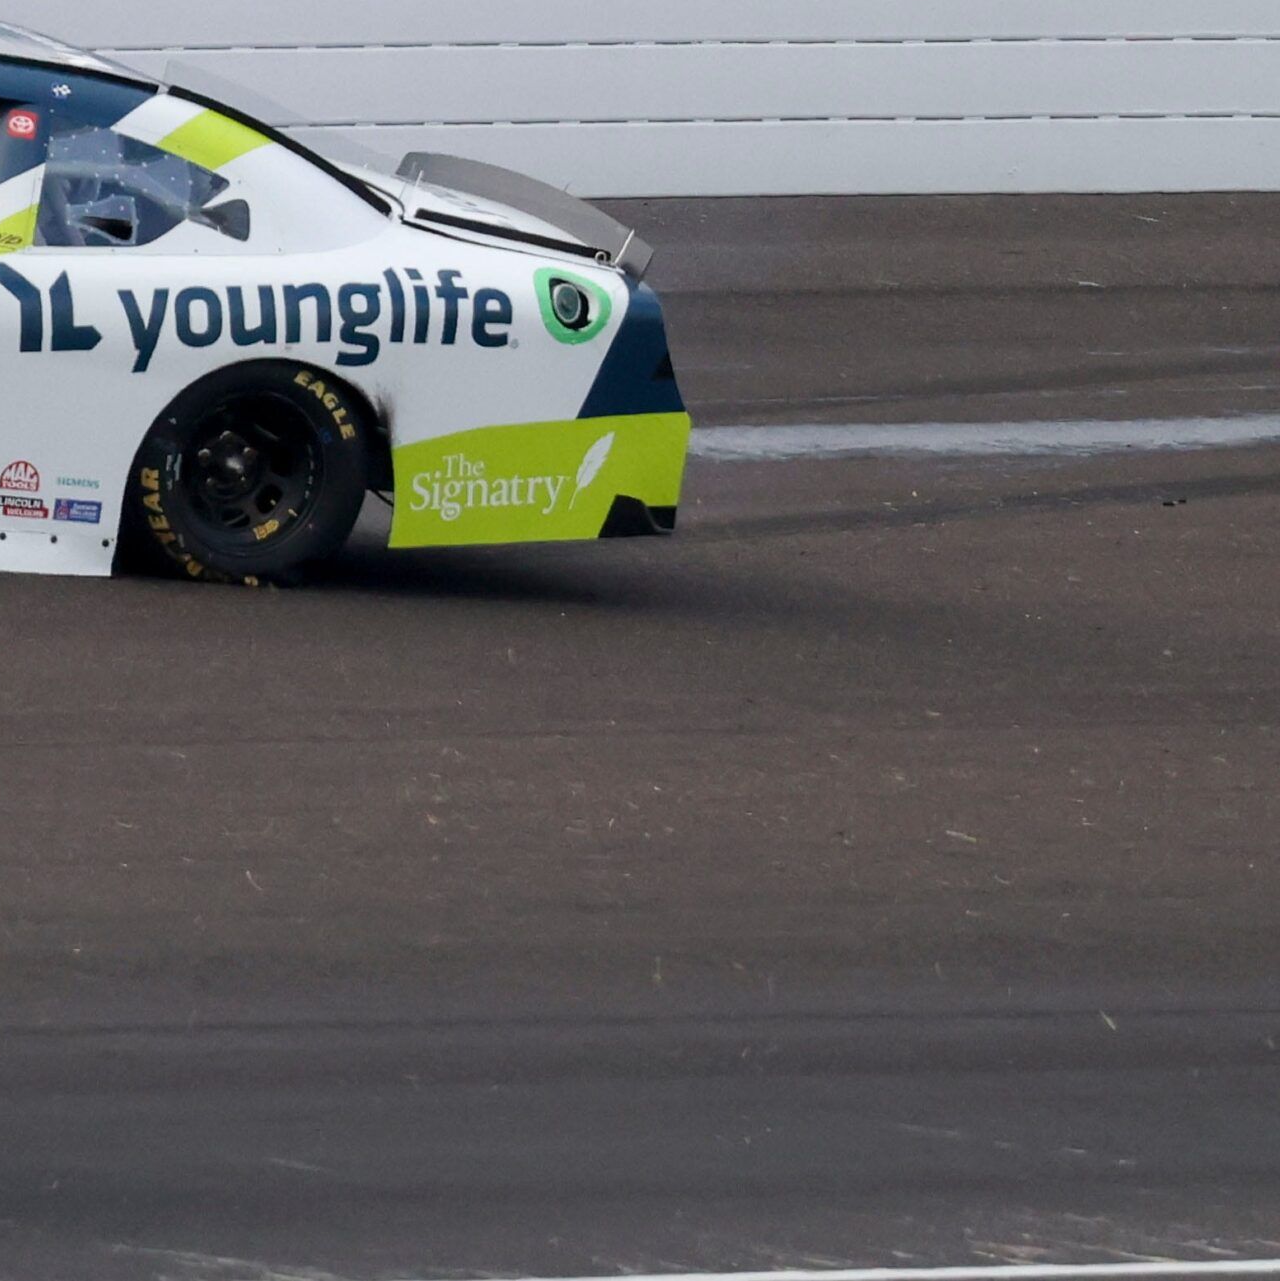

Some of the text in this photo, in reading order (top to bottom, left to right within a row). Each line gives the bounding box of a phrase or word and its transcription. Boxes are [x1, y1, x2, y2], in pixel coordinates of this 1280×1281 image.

[117, 267, 514, 373] younglife
[292, 370, 357, 441] EAGLE
[2, 461, 39, 482] MAC
[442, 453, 485, 478] The
[1, 481, 37, 491] TOOLS
[409, 470, 565, 521] Signatry
